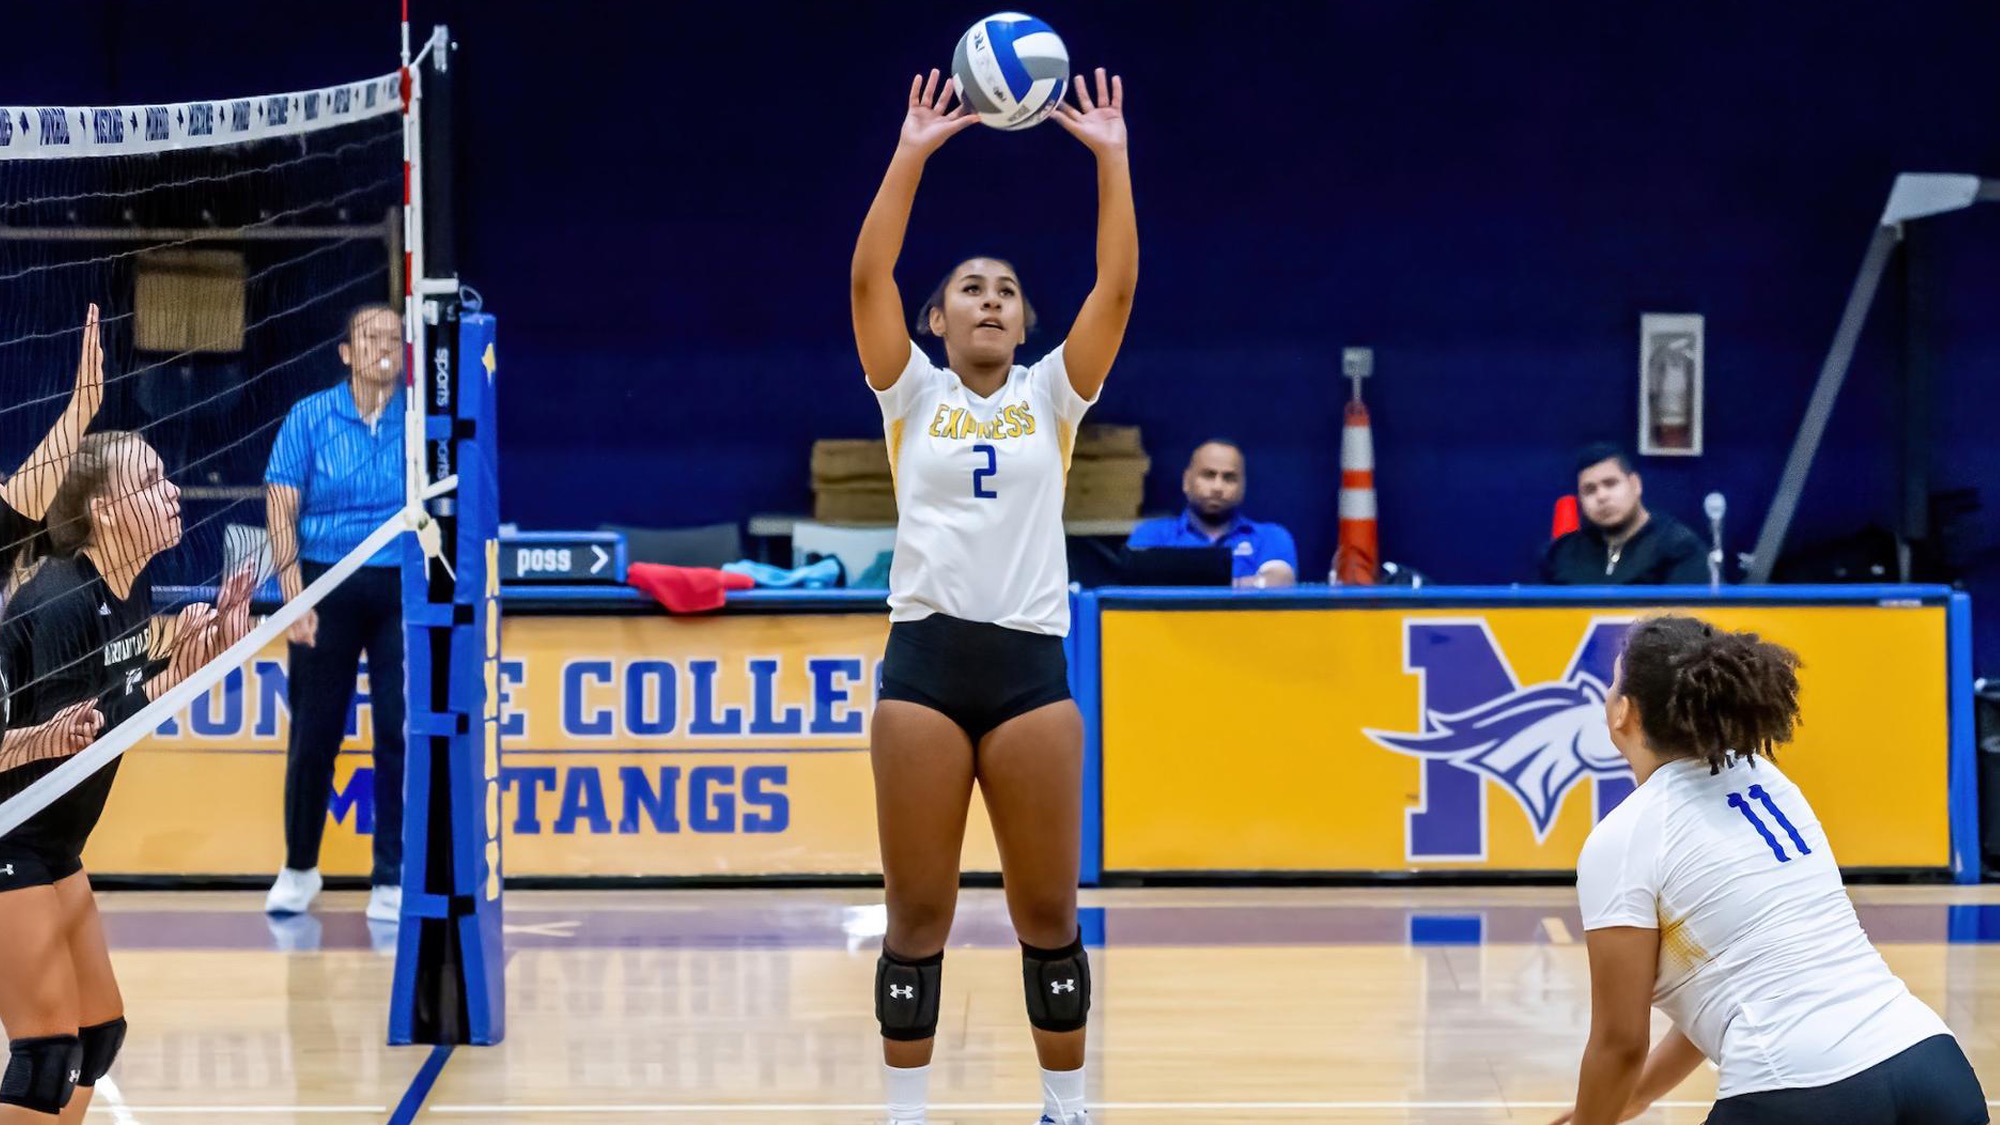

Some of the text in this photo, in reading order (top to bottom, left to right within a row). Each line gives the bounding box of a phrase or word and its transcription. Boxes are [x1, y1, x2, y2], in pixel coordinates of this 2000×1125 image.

[434, 348, 449, 407] sports
[973, 445, 998, 499] 2
[516, 548, 572, 578] poss
[561, 659, 884, 737] COLLE
[327, 765, 790, 834] MTANGS
[1726, 784, 1812, 863] 11
